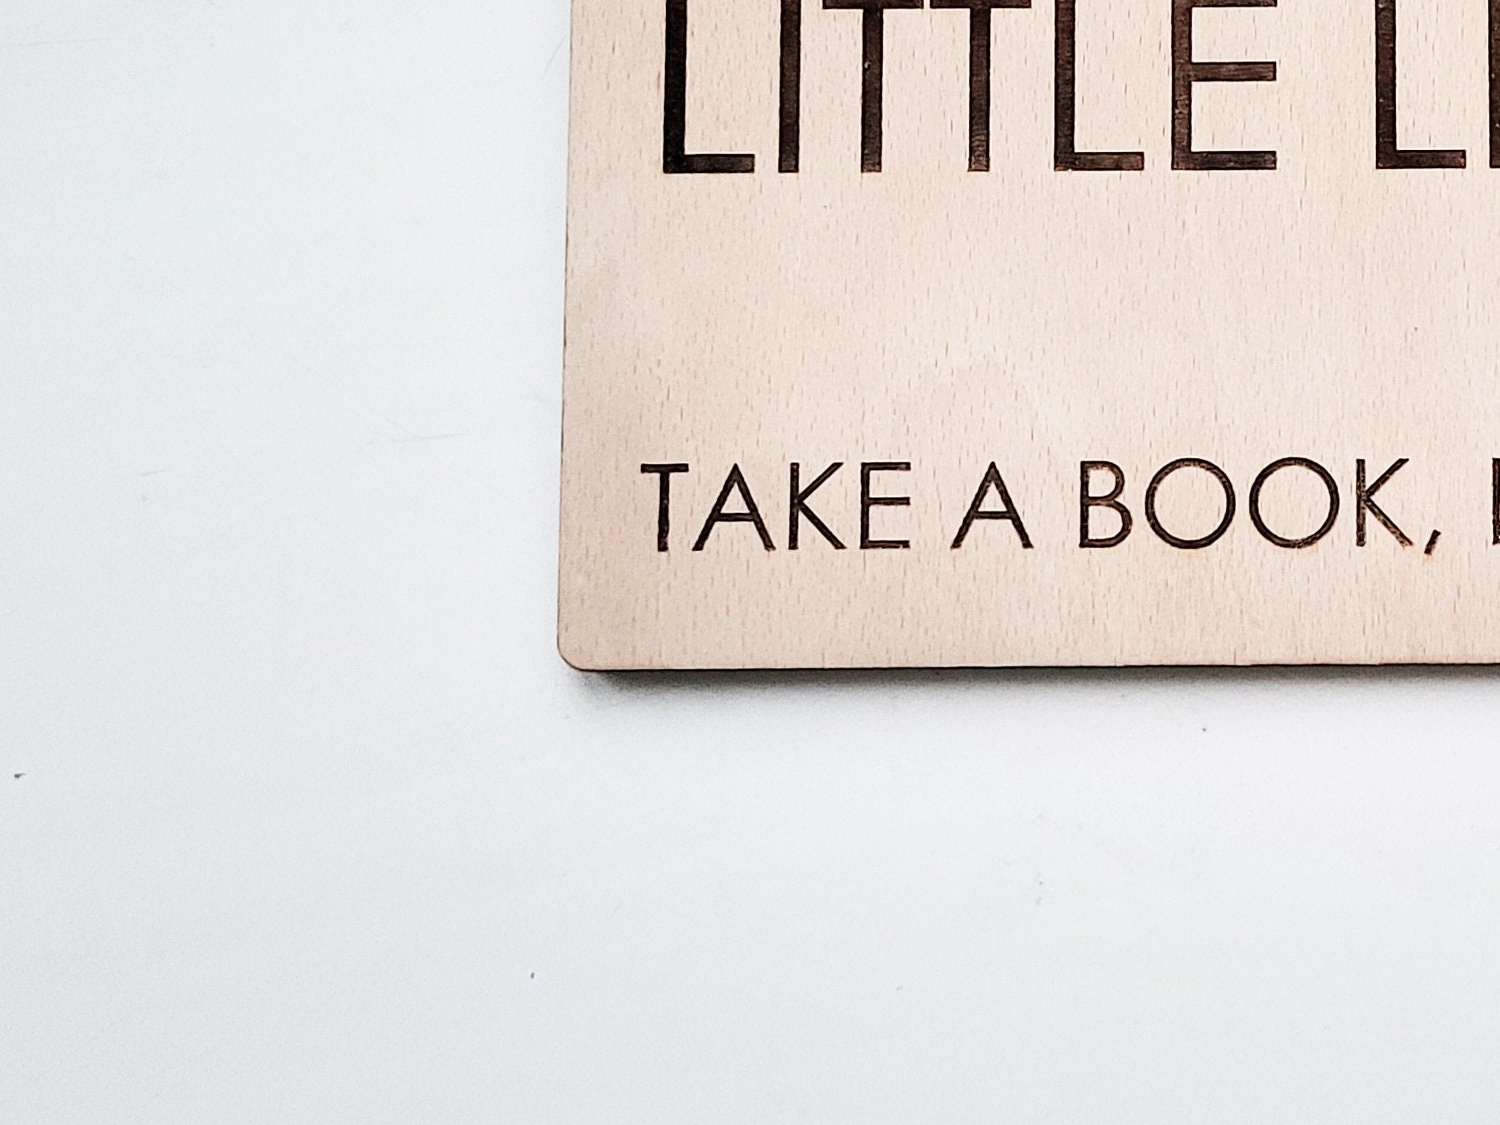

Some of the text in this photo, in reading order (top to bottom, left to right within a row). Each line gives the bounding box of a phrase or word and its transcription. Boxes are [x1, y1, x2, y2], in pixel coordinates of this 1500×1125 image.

[640, 461, 912, 553] TAKE
[950, 461, 1034, 550] A
[1078, 456, 1442, 556] BOOK,
